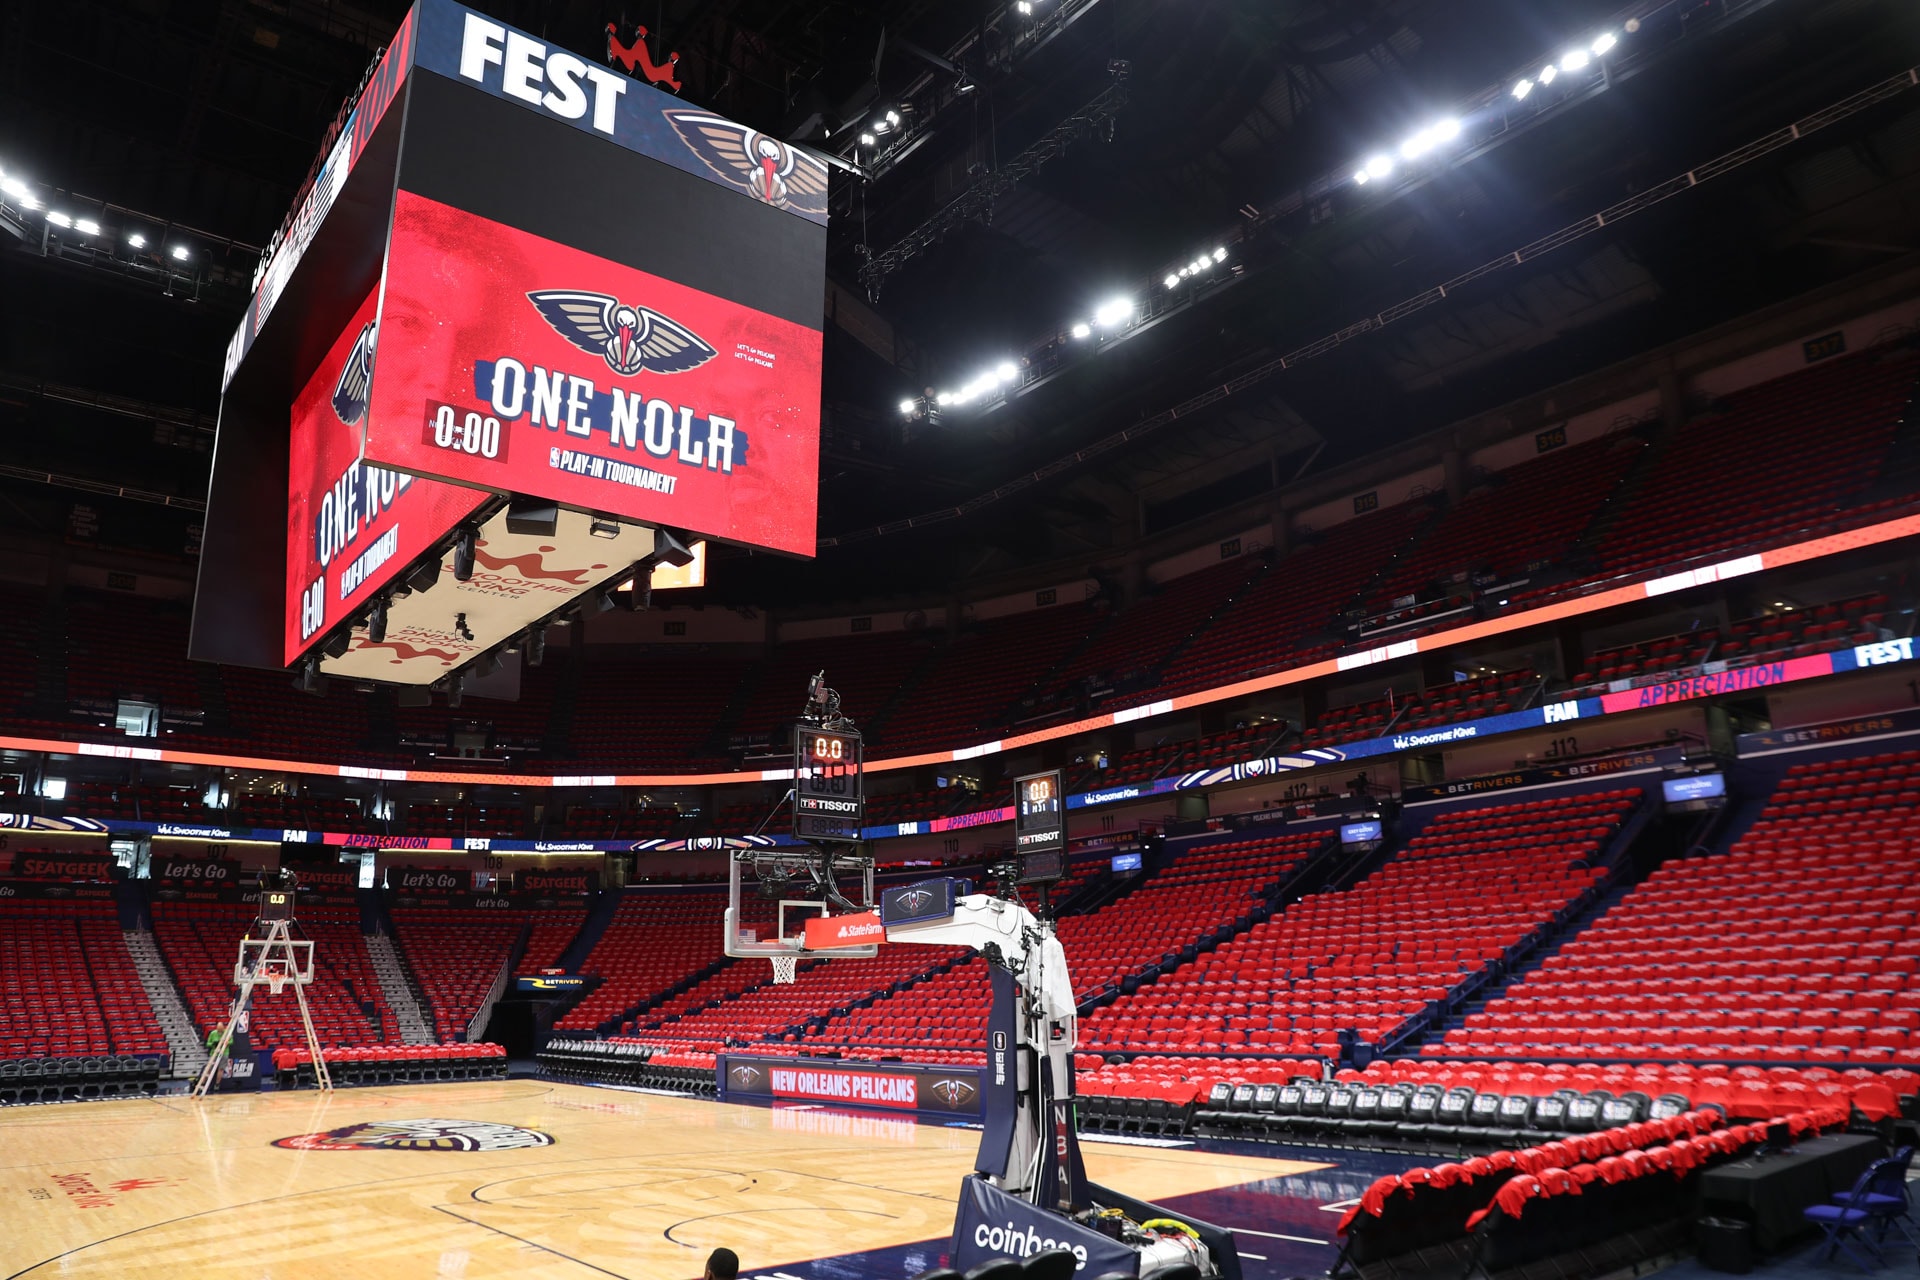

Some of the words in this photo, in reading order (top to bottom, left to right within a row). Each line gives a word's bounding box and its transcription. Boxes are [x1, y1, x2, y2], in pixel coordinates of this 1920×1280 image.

[459, 11, 628, 136] FEST
[1808, 336, 1840, 359] 317
[491, 357, 595, 437] ONE
[610, 387, 737, 473] NOLA
[435, 405, 500, 459] 0:00
[560, 449, 604, 479] PLAY-IN
[605, 460, 678, 495] TOURNAMENT
[320, 459, 360, 568] ONE
[456, 586, 520, 600] CENTER
[1855, 637, 1914, 668] FEST
[1639, 663, 1785, 709] APPRECIATION
[1543, 700, 1579, 724] FAN
[1782, 719, 1895, 744] BETRIVERS
[816, 738, 842, 759] 0.0
[1552, 737, 1579, 755] 113
[1568, 754, 1656, 776] BETRIVERS
[1289, 783, 1308, 797] 112
[1447, 775, 1524, 795] BETRIVERS
[817, 799, 858, 812] TISSOT
[947, 808, 1003, 831] APPRECIATION
[1102, 815, 1115, 831] 111
[283, 830, 308, 842] FAN
[898, 822, 918, 835] FAN
[345, 834, 430, 849] APPRECIATION
[464, 838, 491, 850] FEST
[943, 839, 959, 853] 110
[1030, 831, 1060, 844] TISSOT
[1087, 833, 1134, 847] BETRIVERS
[207, 844, 229, 858] 107
[24, 858, 112, 876] SEATGEEK
[164, 862, 202, 878] Let's
[205, 864, 227, 879] Go
[484, 855, 503, 870] 108
[402, 873, 434, 887] Let's
[437, 874, 457, 888] Go
[524, 875, 589, 889] SEATGEEK
[270, 894, 285, 904] 0.0
[475, 898, 496, 908] Let's
[498, 899, 510, 908] Go
[772, 1069, 797, 1093] NEW
[797, 1071, 851, 1098] ORLEANS
[852, 1074, 915, 1103] PELICANS
